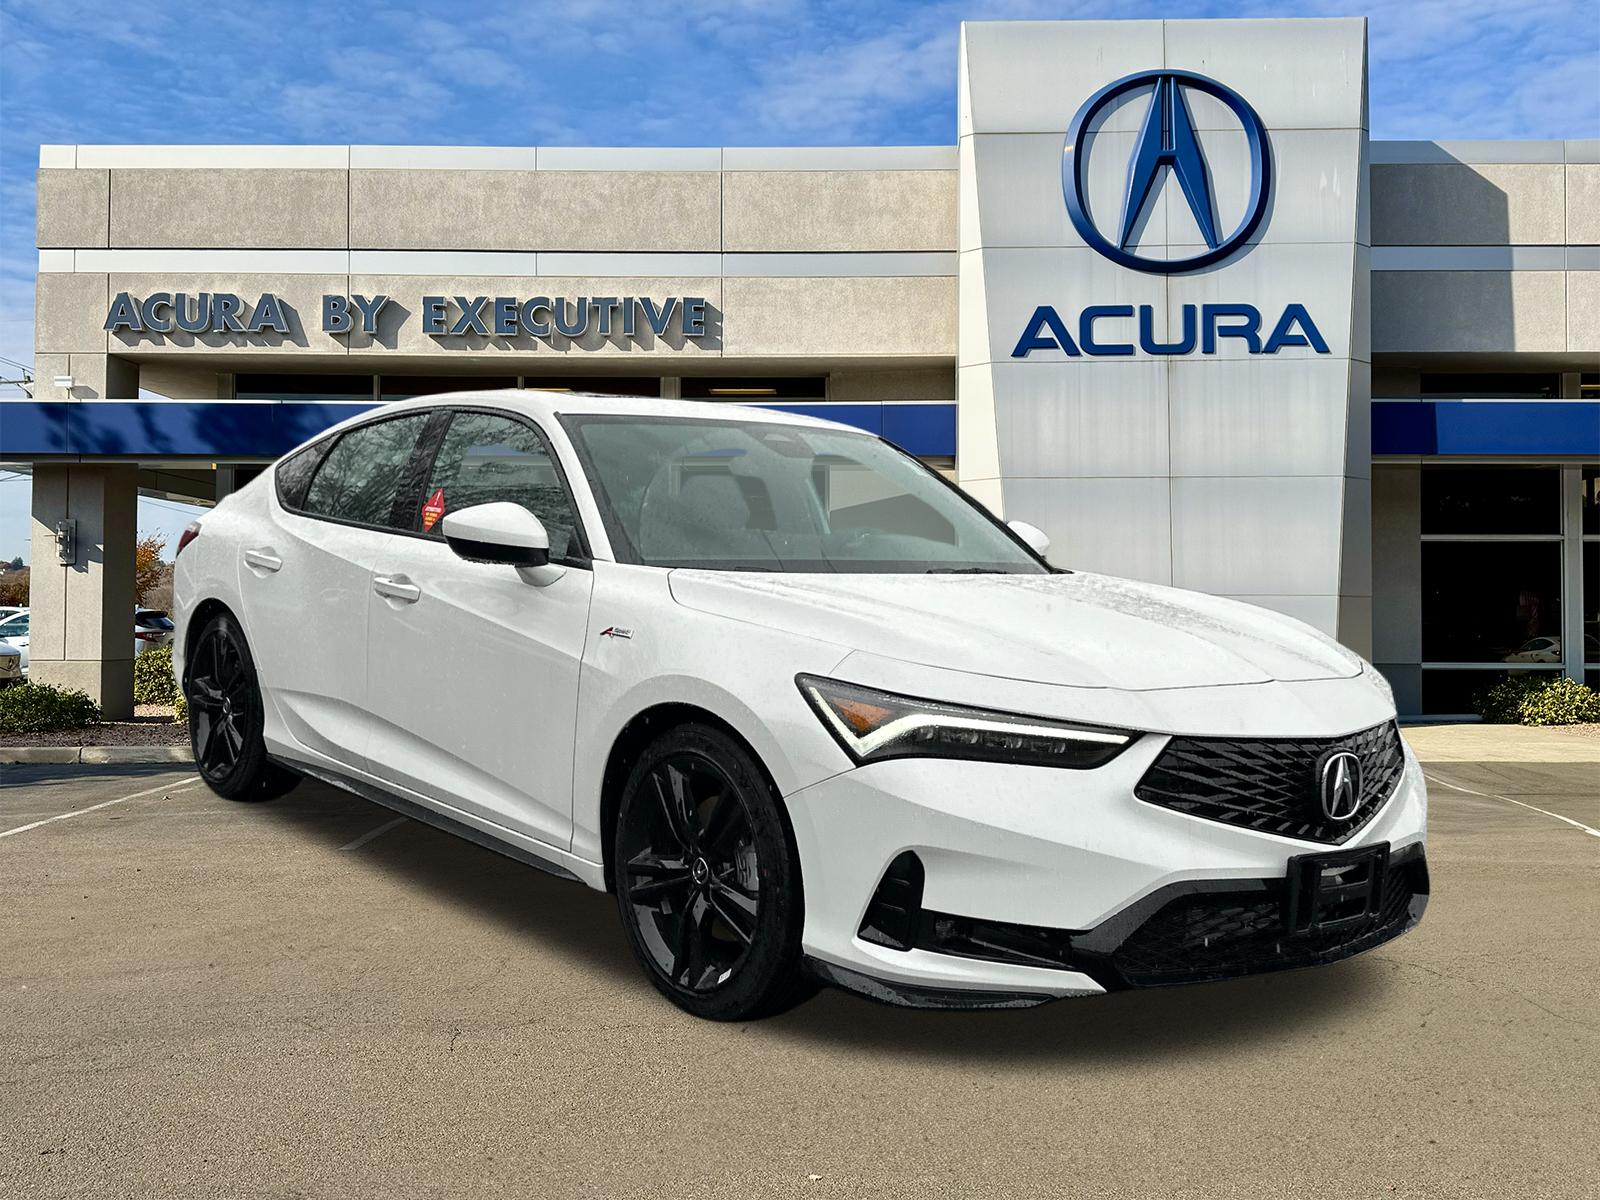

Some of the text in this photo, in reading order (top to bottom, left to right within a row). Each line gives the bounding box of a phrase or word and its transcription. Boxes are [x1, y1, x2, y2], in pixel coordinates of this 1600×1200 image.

[104, 292, 708, 338] ACURA BY EXECUTIVE
[1011, 303, 1331, 357] ACURA
